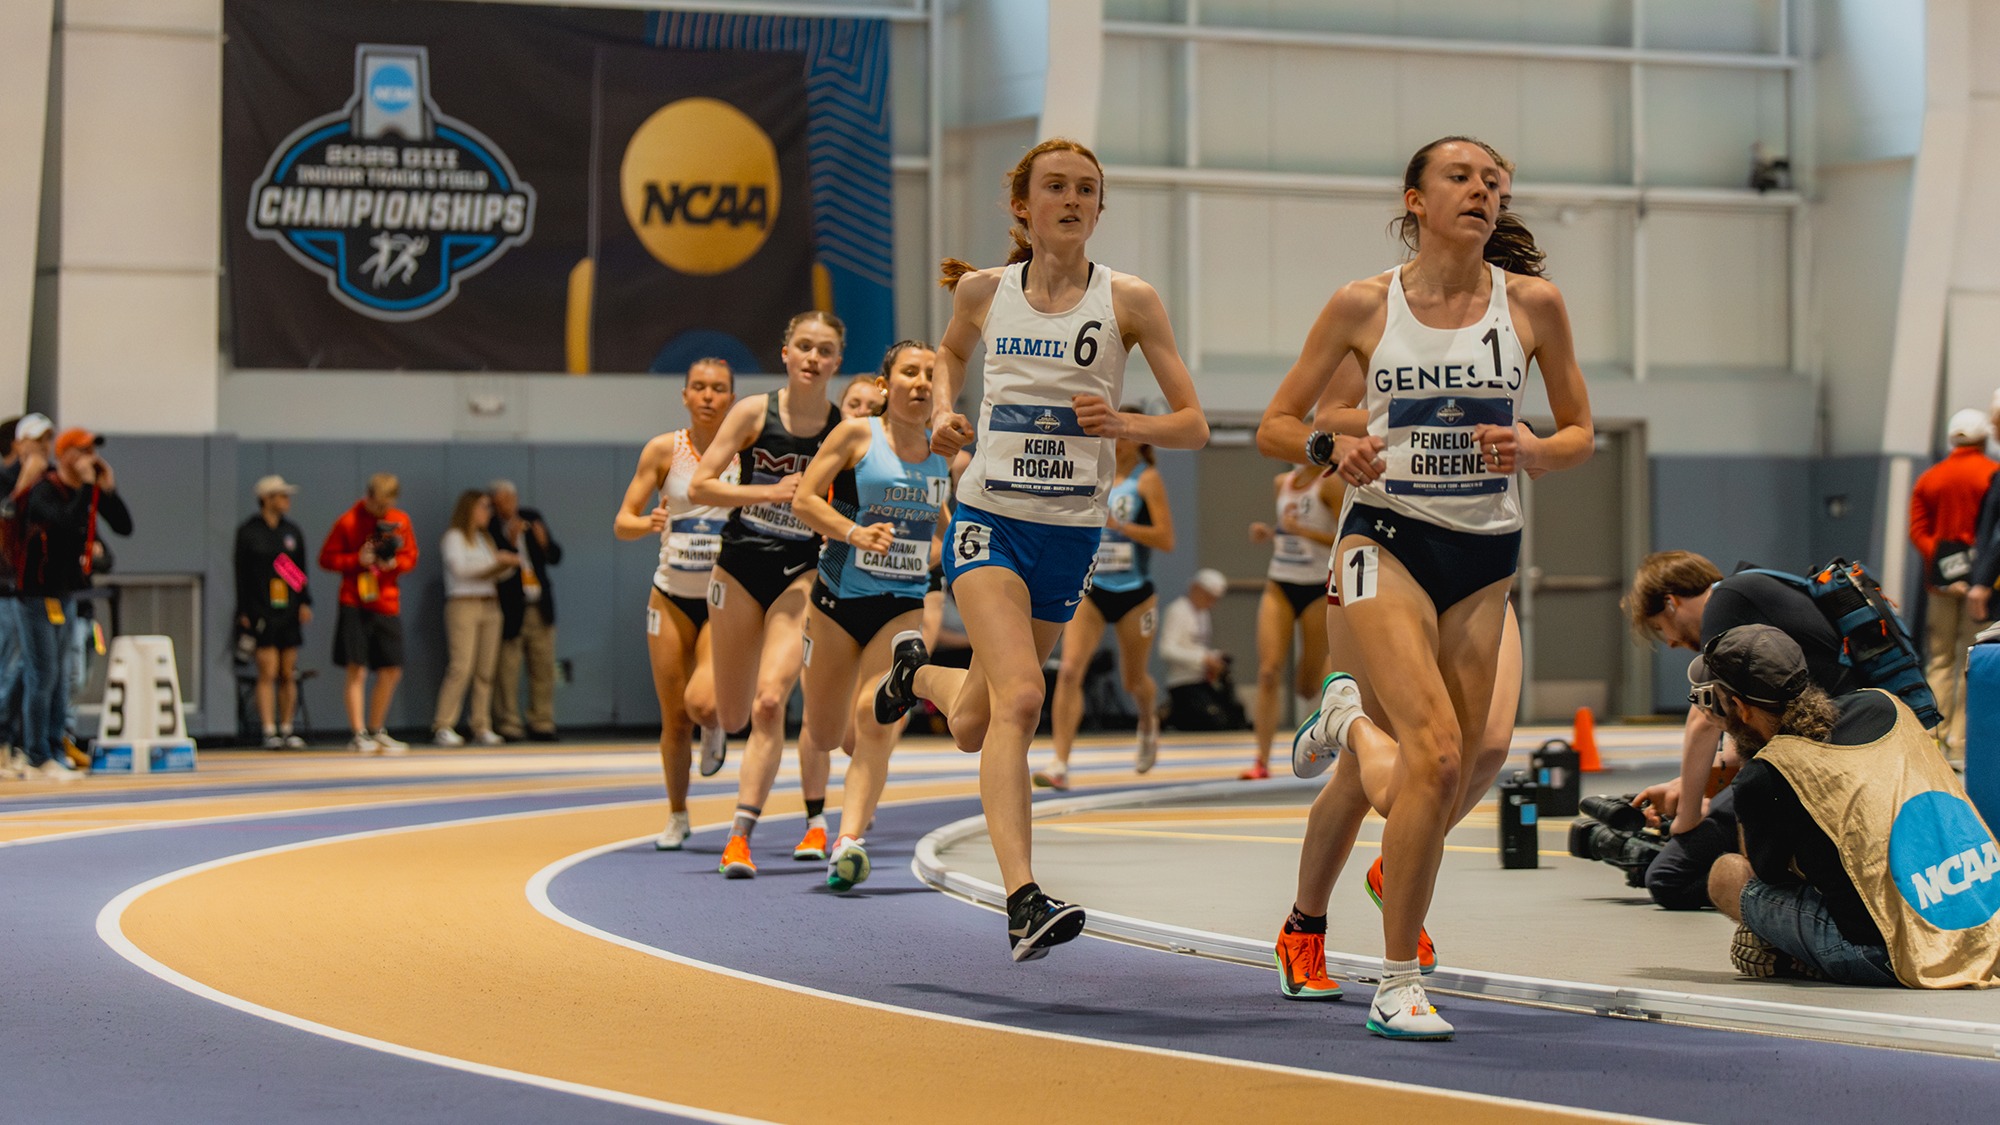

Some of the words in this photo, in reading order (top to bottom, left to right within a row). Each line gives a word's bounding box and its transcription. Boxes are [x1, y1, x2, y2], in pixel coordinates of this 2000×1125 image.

[325, 145, 398, 167] 2025
[257, 186, 526, 232] CHAMPIONSHIPS
[642, 182, 768, 231] NCAA
[995, 337, 1068, 359] HAMIL
[1073, 320, 1102, 367] 6
[1481, 327, 1503, 378] 1
[1375, 364, 1522, 394] GENESO
[752, 447, 815, 474] MI
[1024, 438, 1066, 456] KEIRA
[1012, 457, 1074, 480] ROGAN
[1410, 454, 1486, 476] GREENE
[882, 486, 929, 502] JOHN
[888, 542, 917, 555] RIANA
[958, 524, 982, 560] 6
[862, 552, 922, 571] CATALANO
[1349, 549, 1365, 598] 1
[105, 681, 126, 737] 3
[156, 681, 178, 736] 3
[1910, 841, 2000, 911] NCAA
